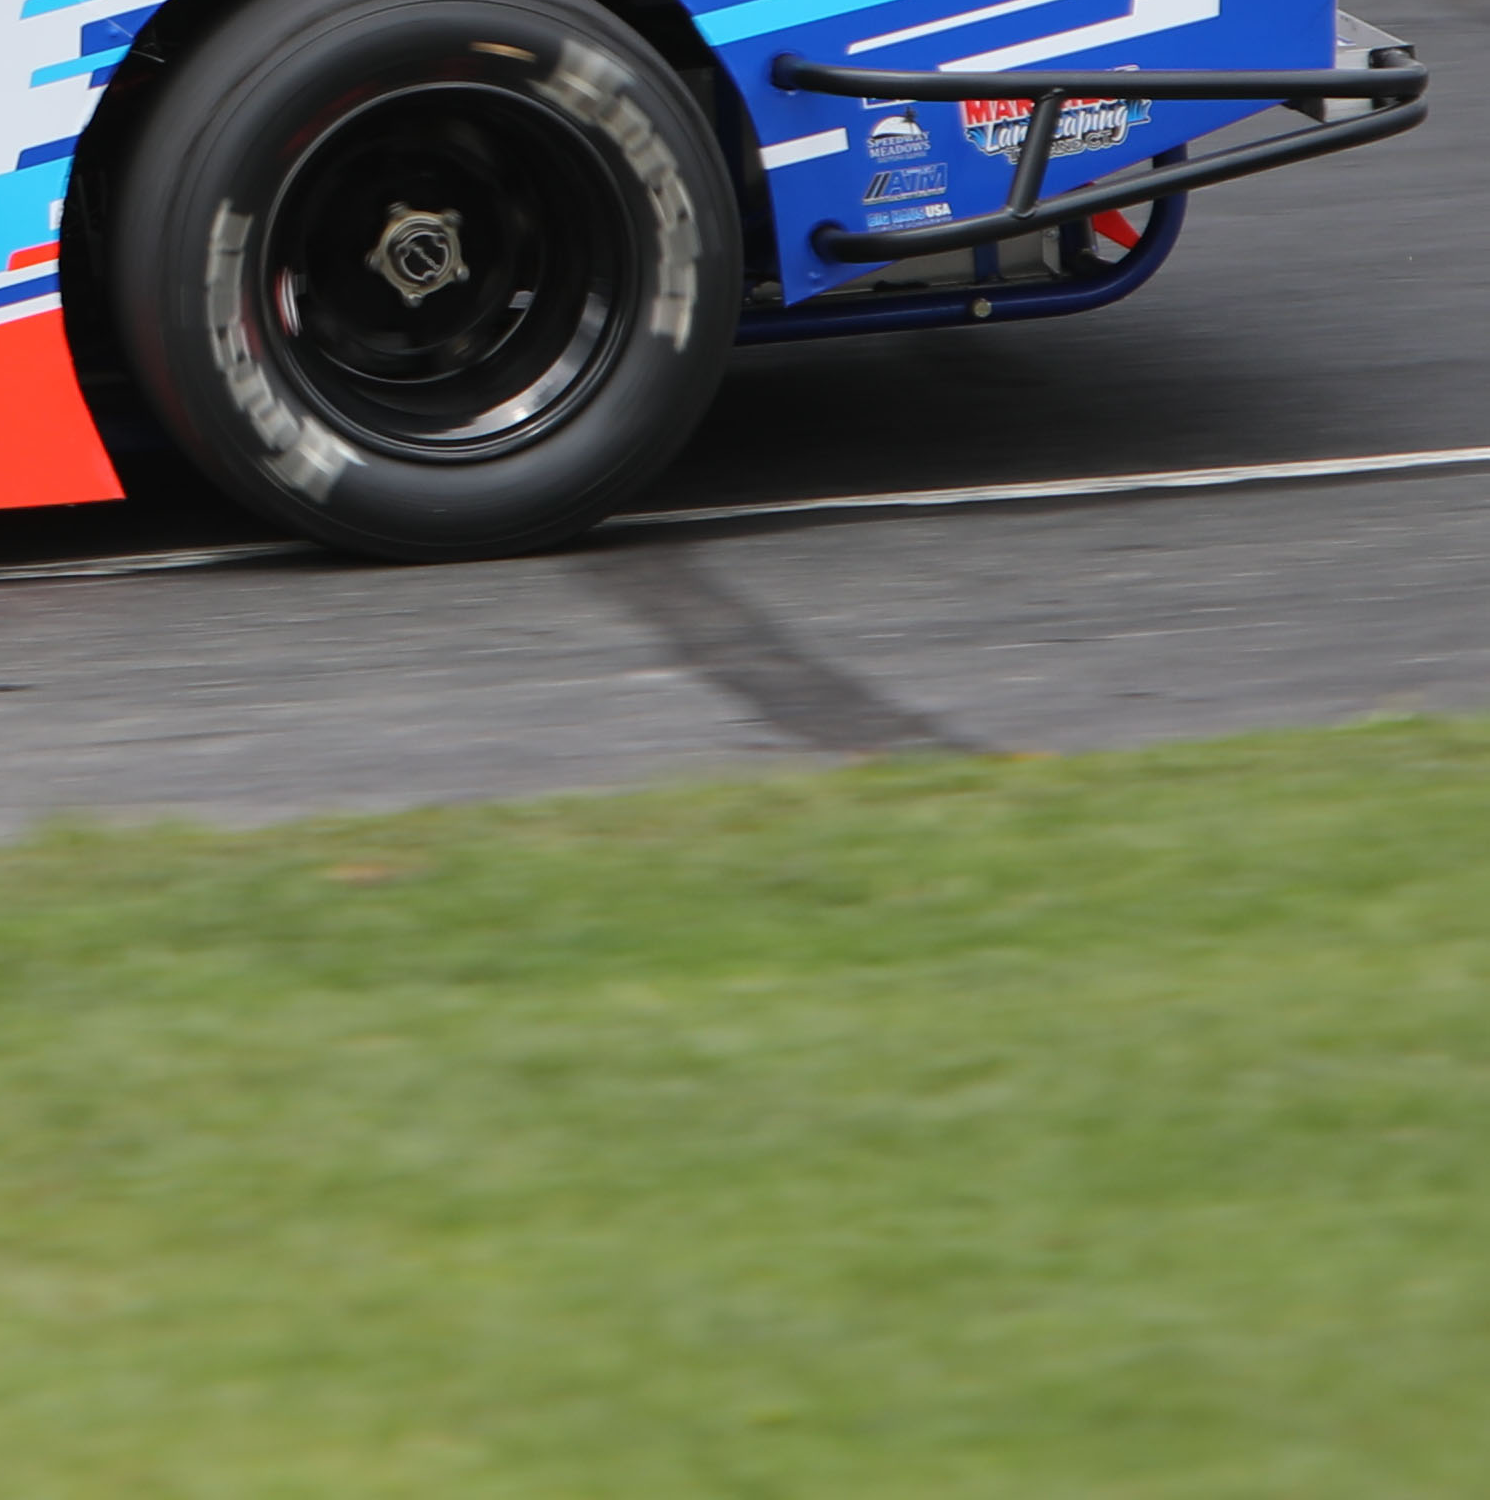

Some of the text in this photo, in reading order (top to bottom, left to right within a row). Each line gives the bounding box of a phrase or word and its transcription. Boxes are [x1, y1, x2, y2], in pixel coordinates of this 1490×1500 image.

[867, 131, 930, 148] SPEEDWAY
[869, 141, 931, 158] MEADOWS
[925, 202, 952, 218] USA
